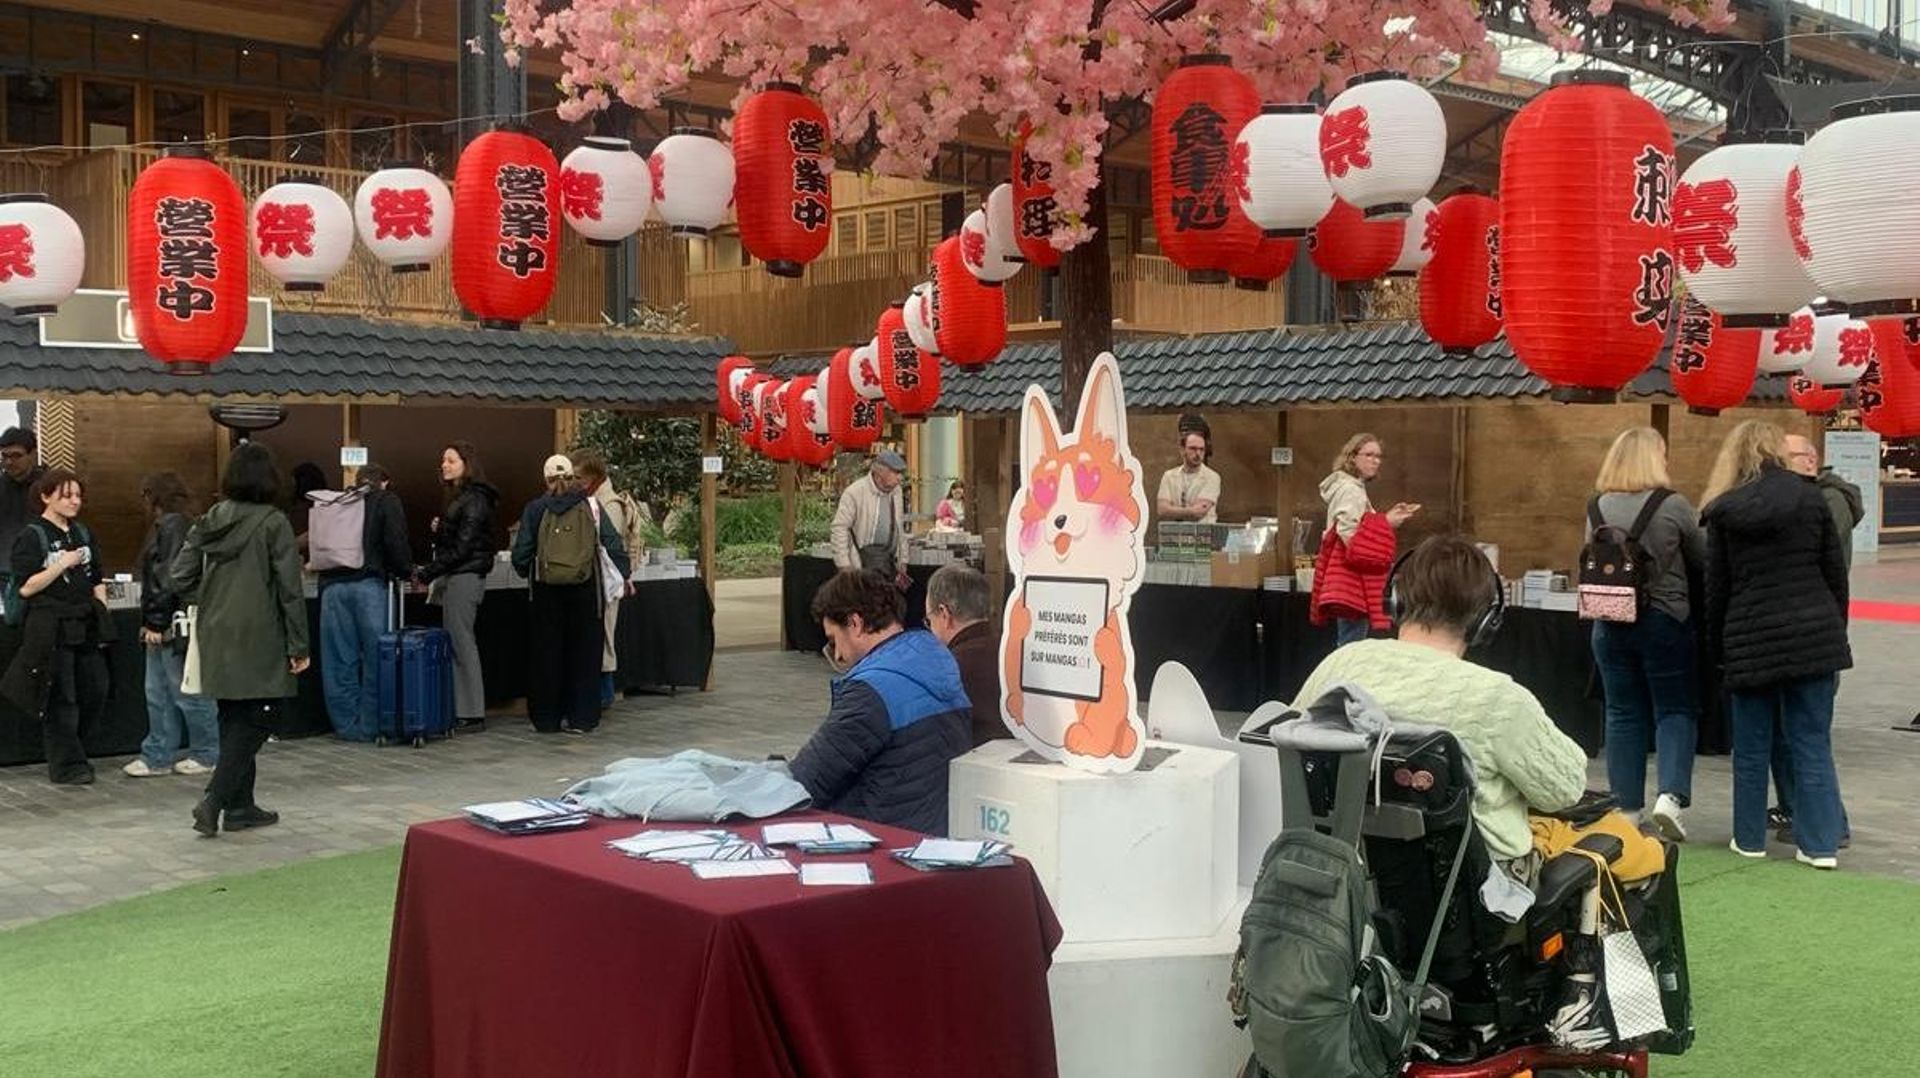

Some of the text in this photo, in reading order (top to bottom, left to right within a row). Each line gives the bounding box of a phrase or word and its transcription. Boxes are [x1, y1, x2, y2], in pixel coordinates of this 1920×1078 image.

[370, 187, 433, 241] 祭
[1671, 178, 1738, 273] 祭
[256, 202, 315, 258] 祭
[1038, 611, 1087, 625] MES MANGAS
[1068, 634, 1088, 647] SONT
[1031, 651, 1044, 662] SUR
[1046, 653, 1077, 667] MANGAS
[980, 806, 1010, 835] 162
